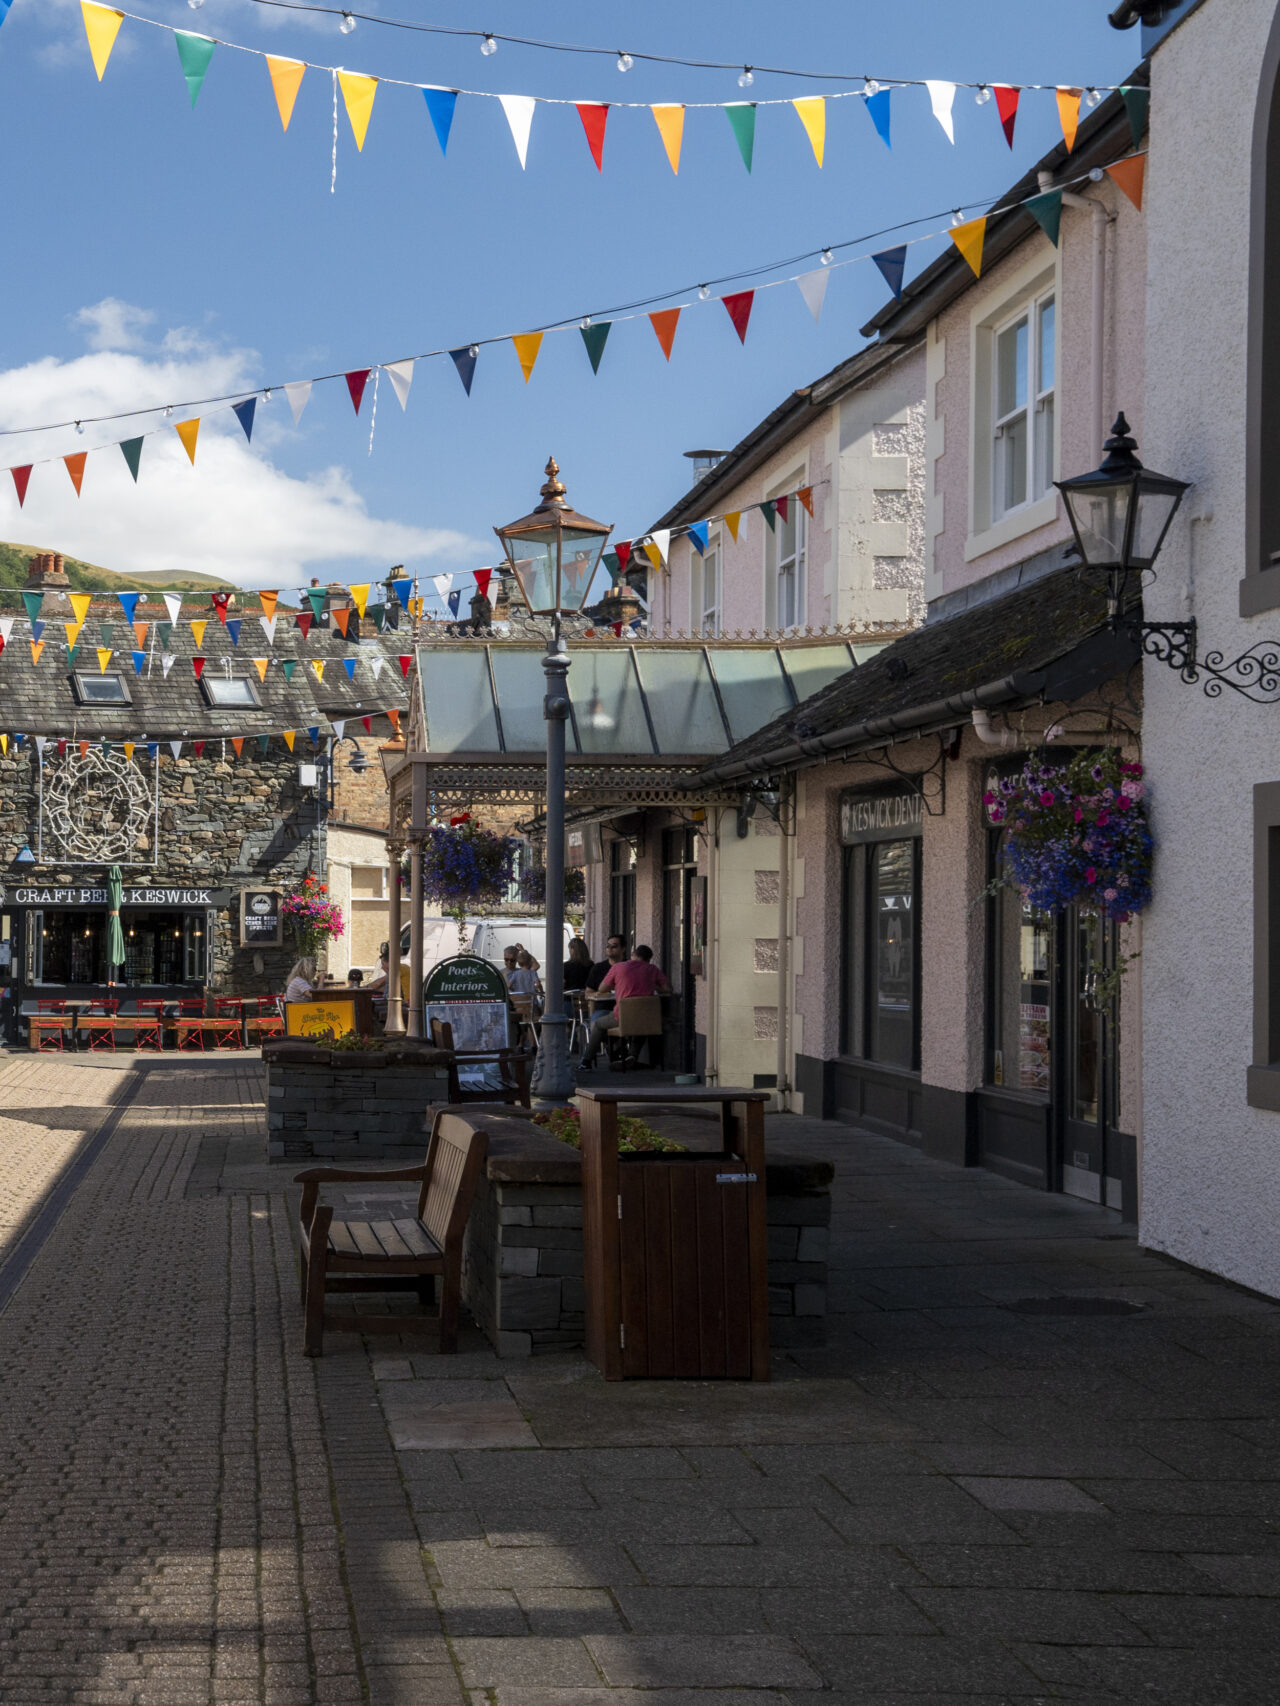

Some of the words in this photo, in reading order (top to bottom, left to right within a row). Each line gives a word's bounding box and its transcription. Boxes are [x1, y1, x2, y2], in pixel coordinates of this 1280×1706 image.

[852, 798, 893, 832] KESWICK
[15, 888, 76, 903] CRAFT
[129, 889, 212, 903] KESWICK
[440, 981, 489, 992] Interiors
